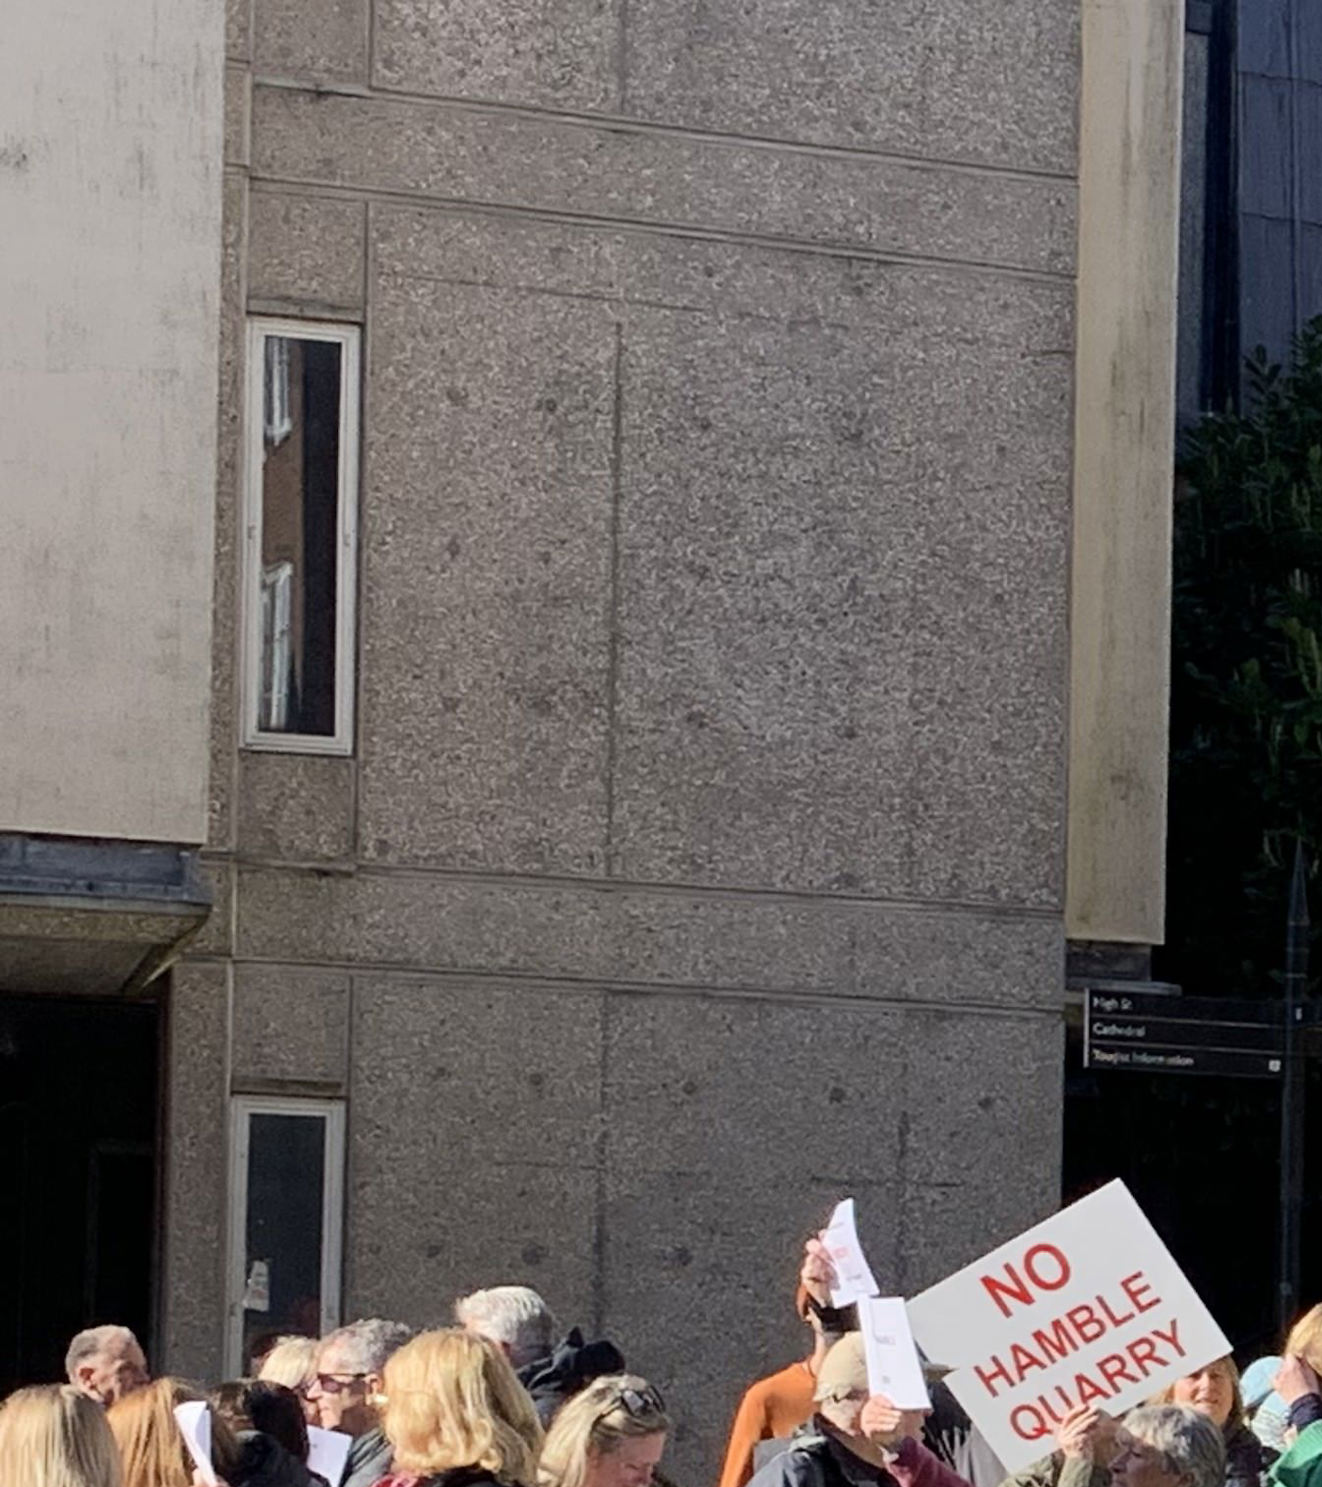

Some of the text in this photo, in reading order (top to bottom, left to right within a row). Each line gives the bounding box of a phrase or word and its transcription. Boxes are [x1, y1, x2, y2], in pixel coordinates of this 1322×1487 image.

[1093, 1023, 1146, 1037] Cathedral
[980, 1243, 1071, 1318] NO
[974, 1271, 1162, 1398] HAMBLE
[1010, 1318, 1186, 1440] QUARRY
